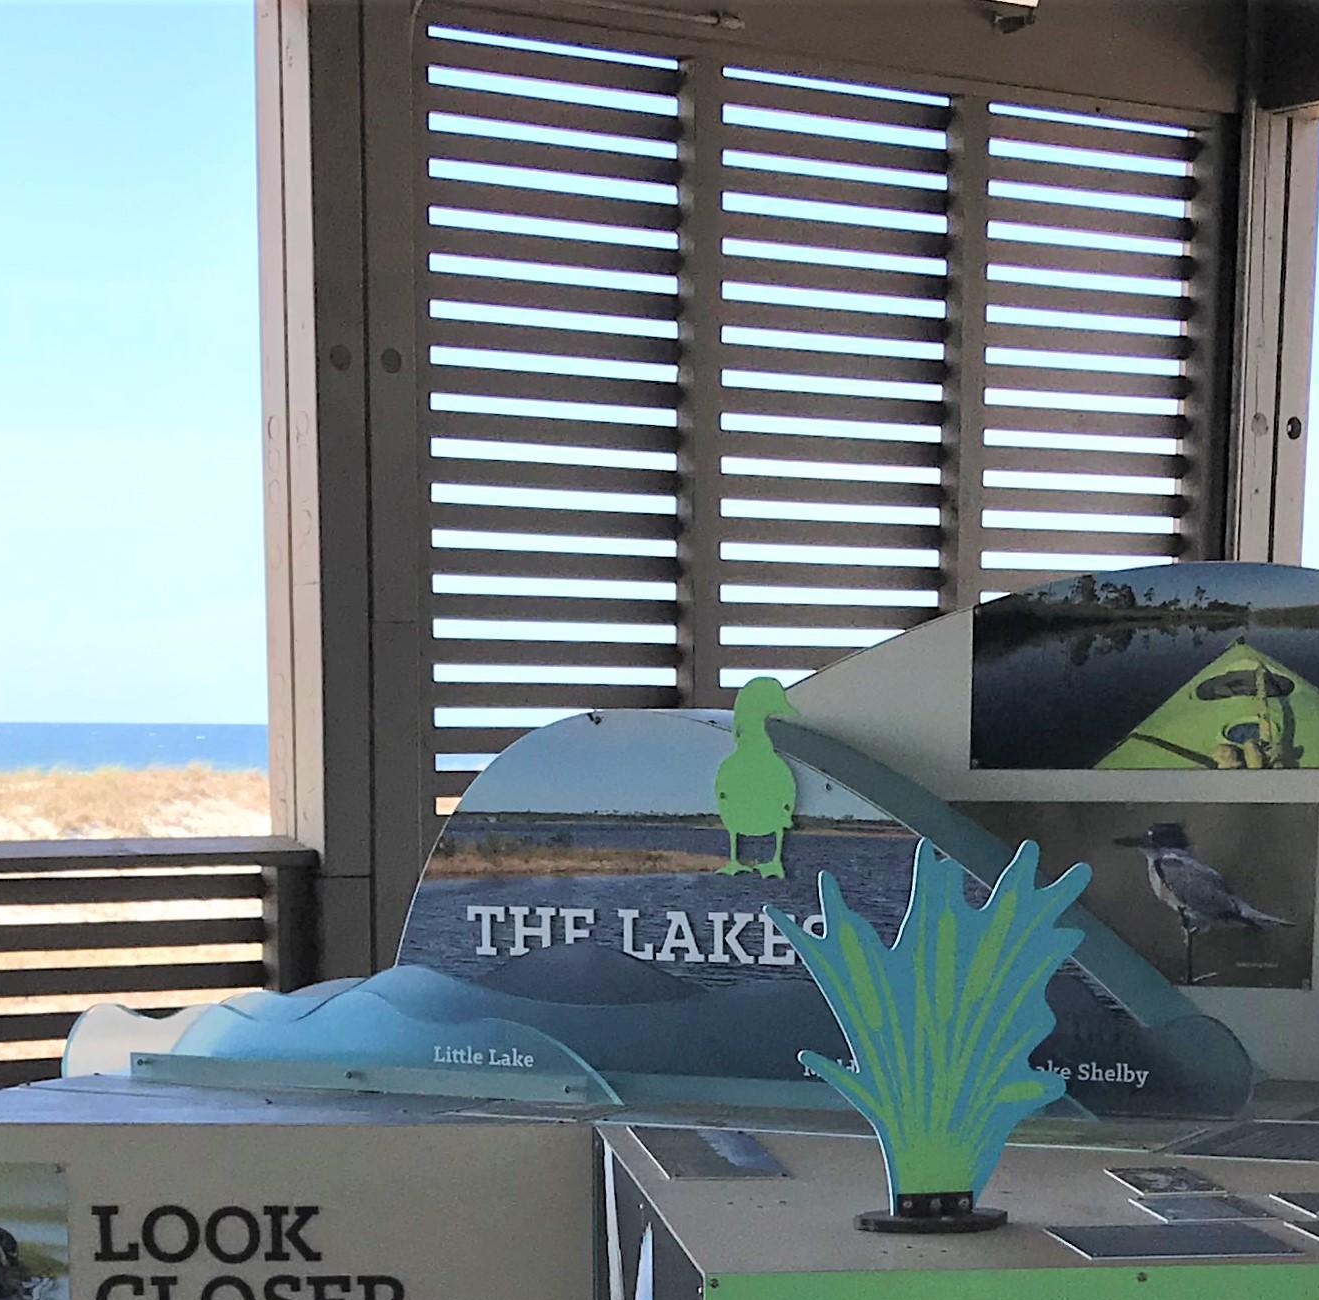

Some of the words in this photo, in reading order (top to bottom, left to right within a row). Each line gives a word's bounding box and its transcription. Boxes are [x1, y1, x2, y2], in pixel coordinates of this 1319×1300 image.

[467, 905, 595, 957] THE
[433, 1045, 484, 1065] Little
[488, 1048, 535, 1068] Lake
[1078, 1061, 1150, 1089] Shelby
[91, 1204, 322, 1264] LOOK
